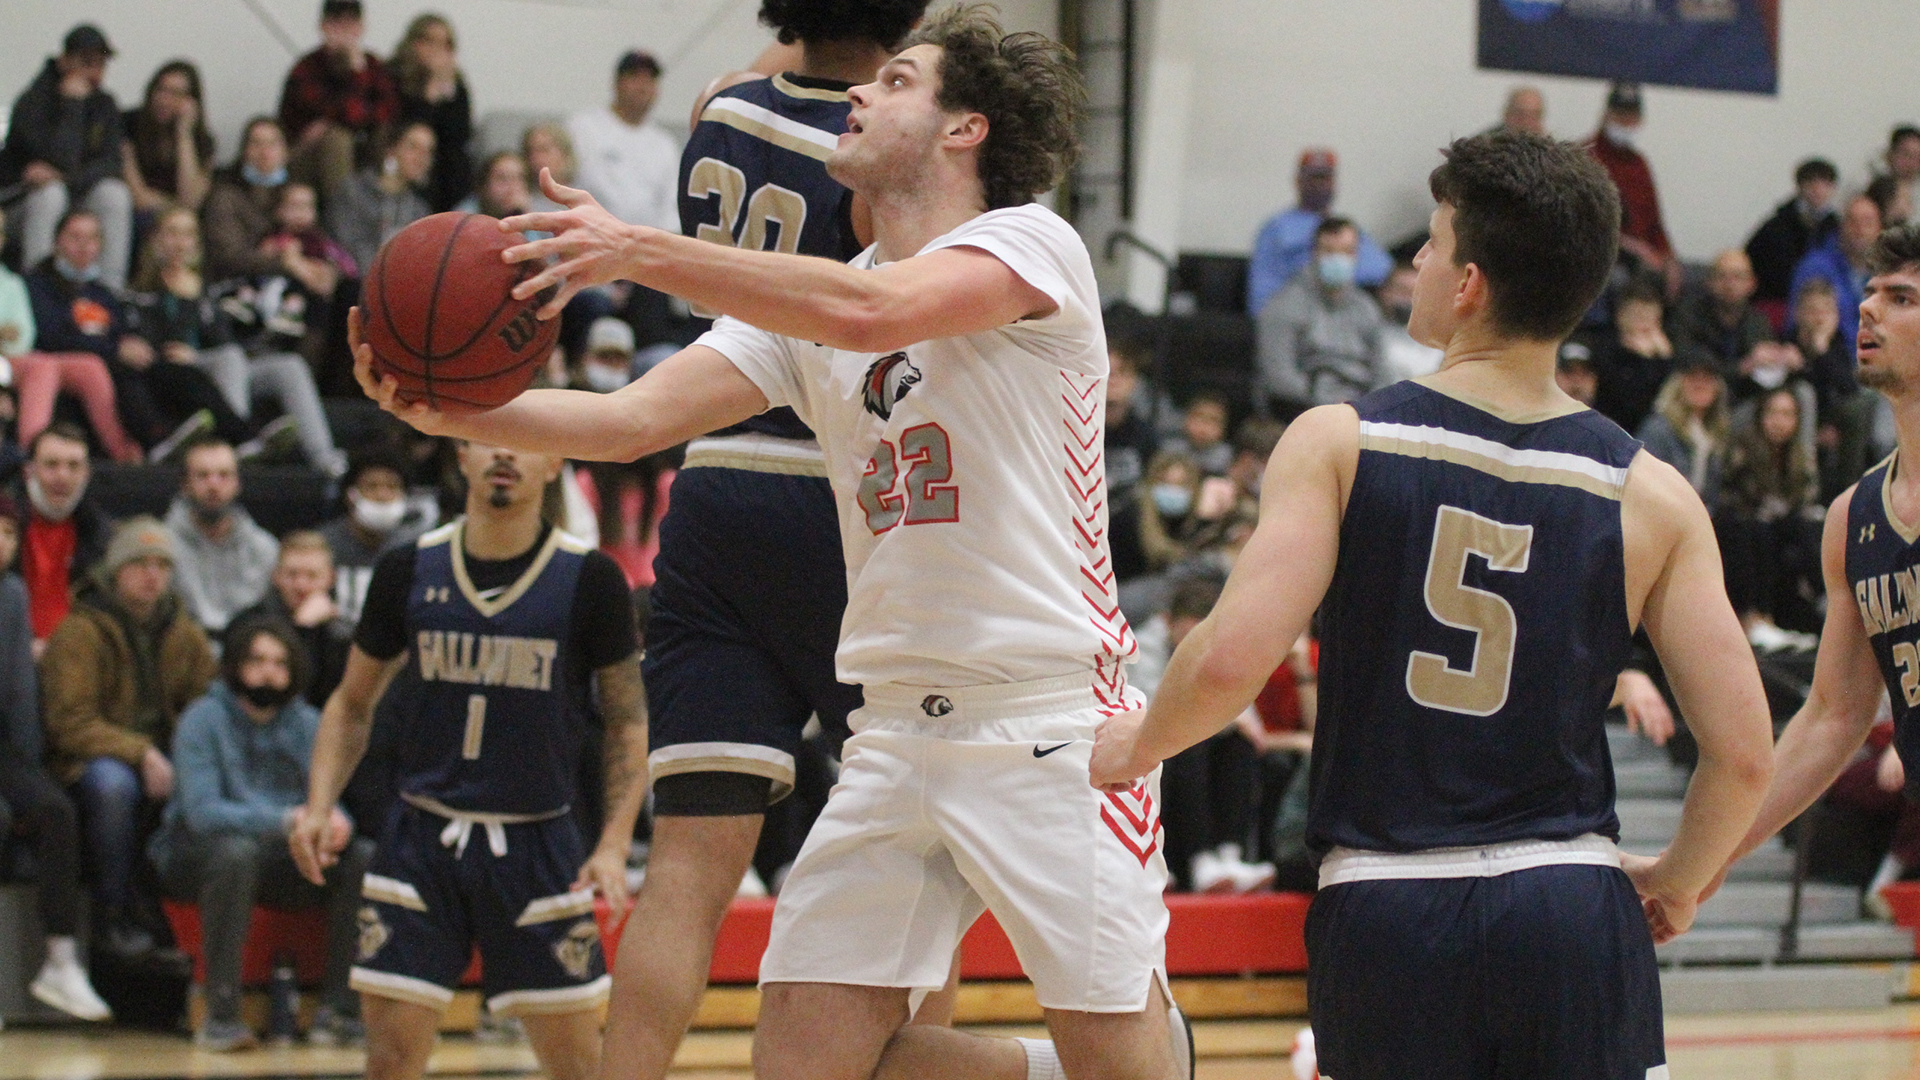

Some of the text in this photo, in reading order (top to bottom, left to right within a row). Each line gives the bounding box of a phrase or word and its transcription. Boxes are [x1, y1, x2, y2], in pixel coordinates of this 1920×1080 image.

[857, 421, 960, 536] 22
[1405, 504, 1534, 717] 5
[1892, 640, 1920, 709] 2
[462, 693, 487, 761] 1
